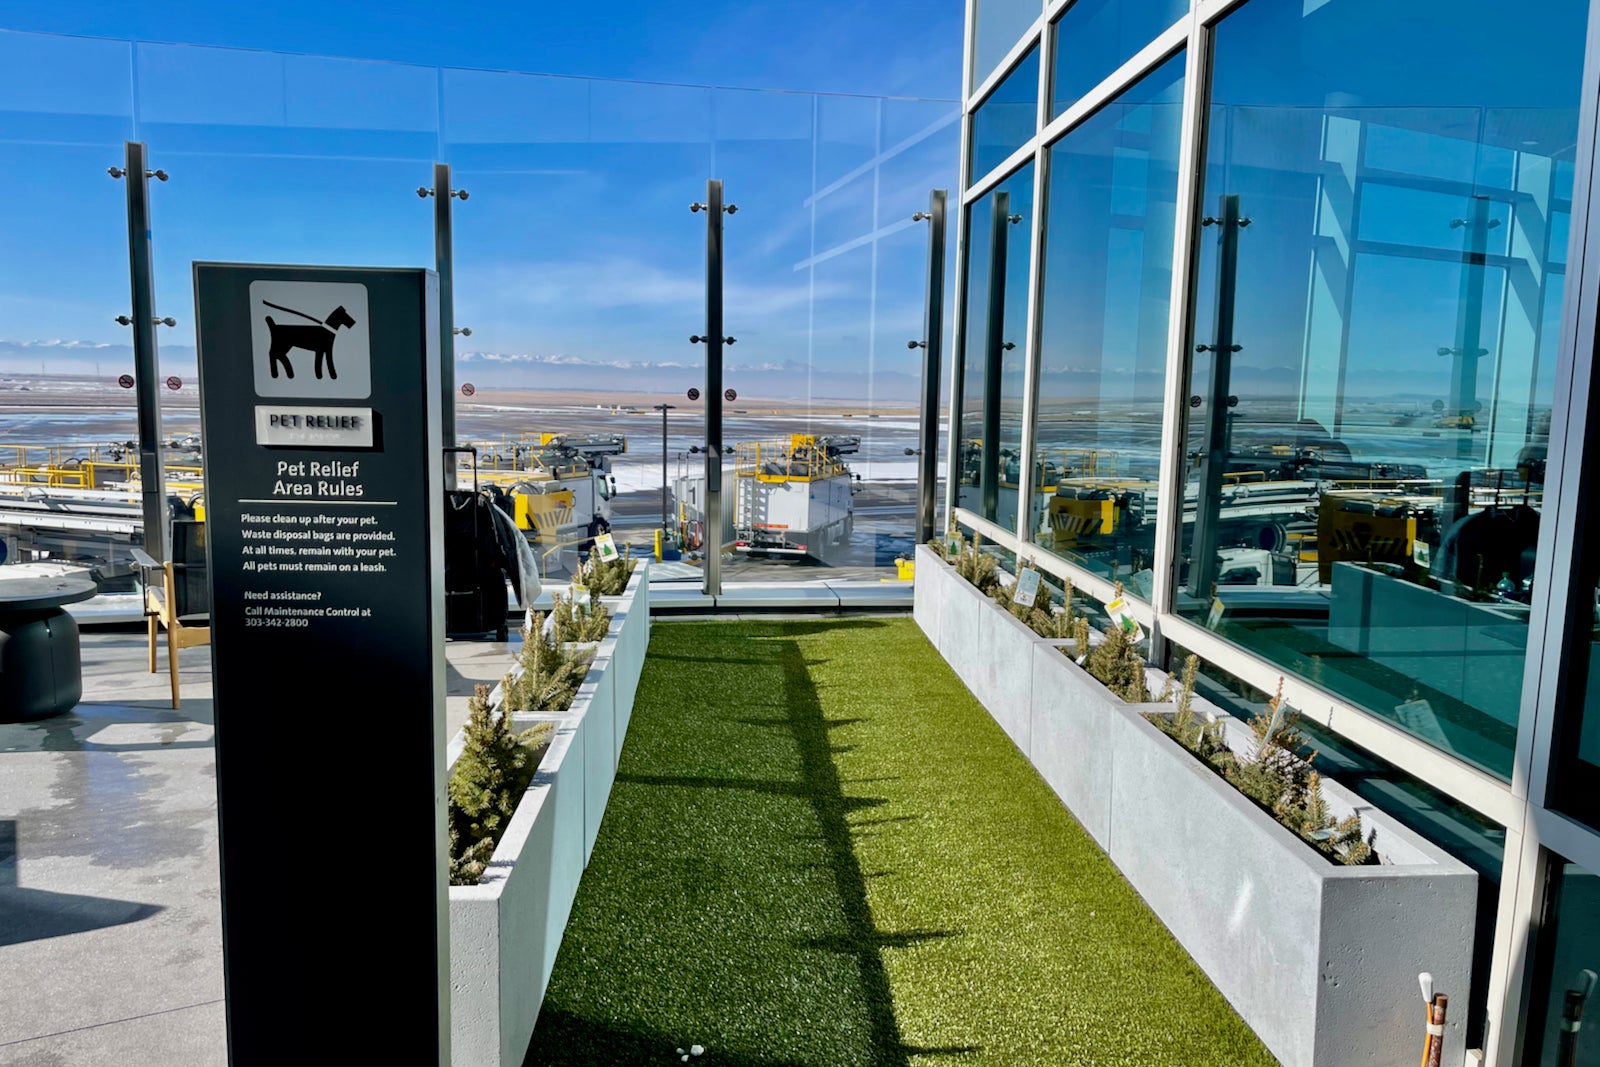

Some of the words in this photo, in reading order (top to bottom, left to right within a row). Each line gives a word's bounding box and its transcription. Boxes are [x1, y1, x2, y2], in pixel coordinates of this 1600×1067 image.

[270, 414, 299, 427] PET
[306, 415, 360, 428] RELIEF
[277, 461, 305, 476] Pet
[310, 461, 360, 477] Relief
[272, 480, 313, 495] Area
[318, 481, 364, 496] Rules
[240, 513, 271, 523] Please
[272, 514, 297, 523] clean
[299, 516, 311, 525] up
[313, 514, 336, 524] after
[337, 516, 358, 526] your
[360, 516, 378, 527] pet.
[241, 530, 271, 539] Waste
[273, 530, 311, 541] disposal
[313, 531, 334, 542] bags
[353, 531, 395, 541] provided.
[242, 546, 254, 555] At
[255, 546, 267, 555] all
[299, 547, 331, 556] remain
[333, 547, 354, 556] with
[355, 549, 377, 558] your
[379, 548, 397, 558] pet.
[243, 561, 256, 571] All
[257, 562, 277, 572] pets
[279, 562, 303, 571] must
[305, 562, 337, 571] remain
[360, 563, 387, 572] leash.
[244, 591, 269, 600] Need
[270, 591, 322, 600] assistance?
[245, 607, 263, 616] Call
[264, 607, 325, 616] Maintenance
[326, 607, 360, 616] Control
[361, 608, 371, 616] at
[245, 618, 309, 627] 303-342-2800
